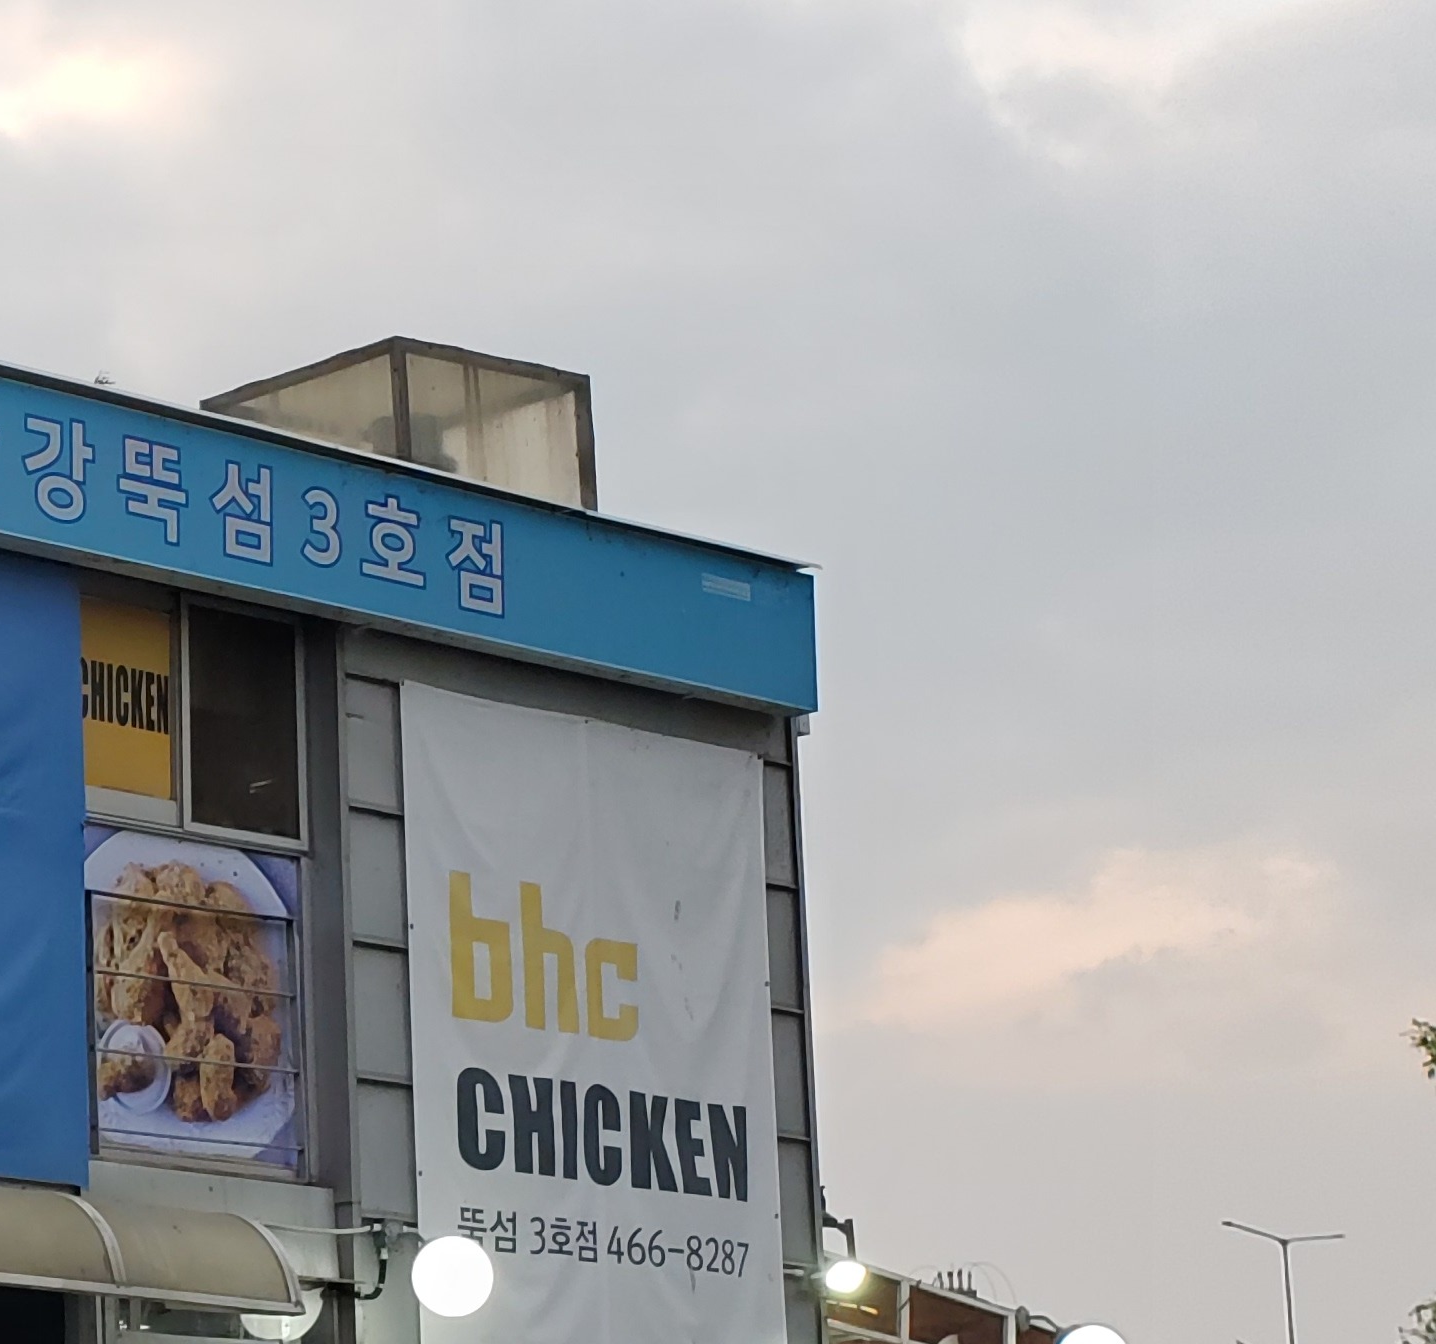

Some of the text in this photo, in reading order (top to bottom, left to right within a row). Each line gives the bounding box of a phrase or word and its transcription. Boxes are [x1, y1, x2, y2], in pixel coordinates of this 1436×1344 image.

[449, 870, 640, 1043] bhc
[456, 1067, 749, 1203] CHICKEN
[457, 1206, 750, 1278] 뚝섬 3호점 466-8287
